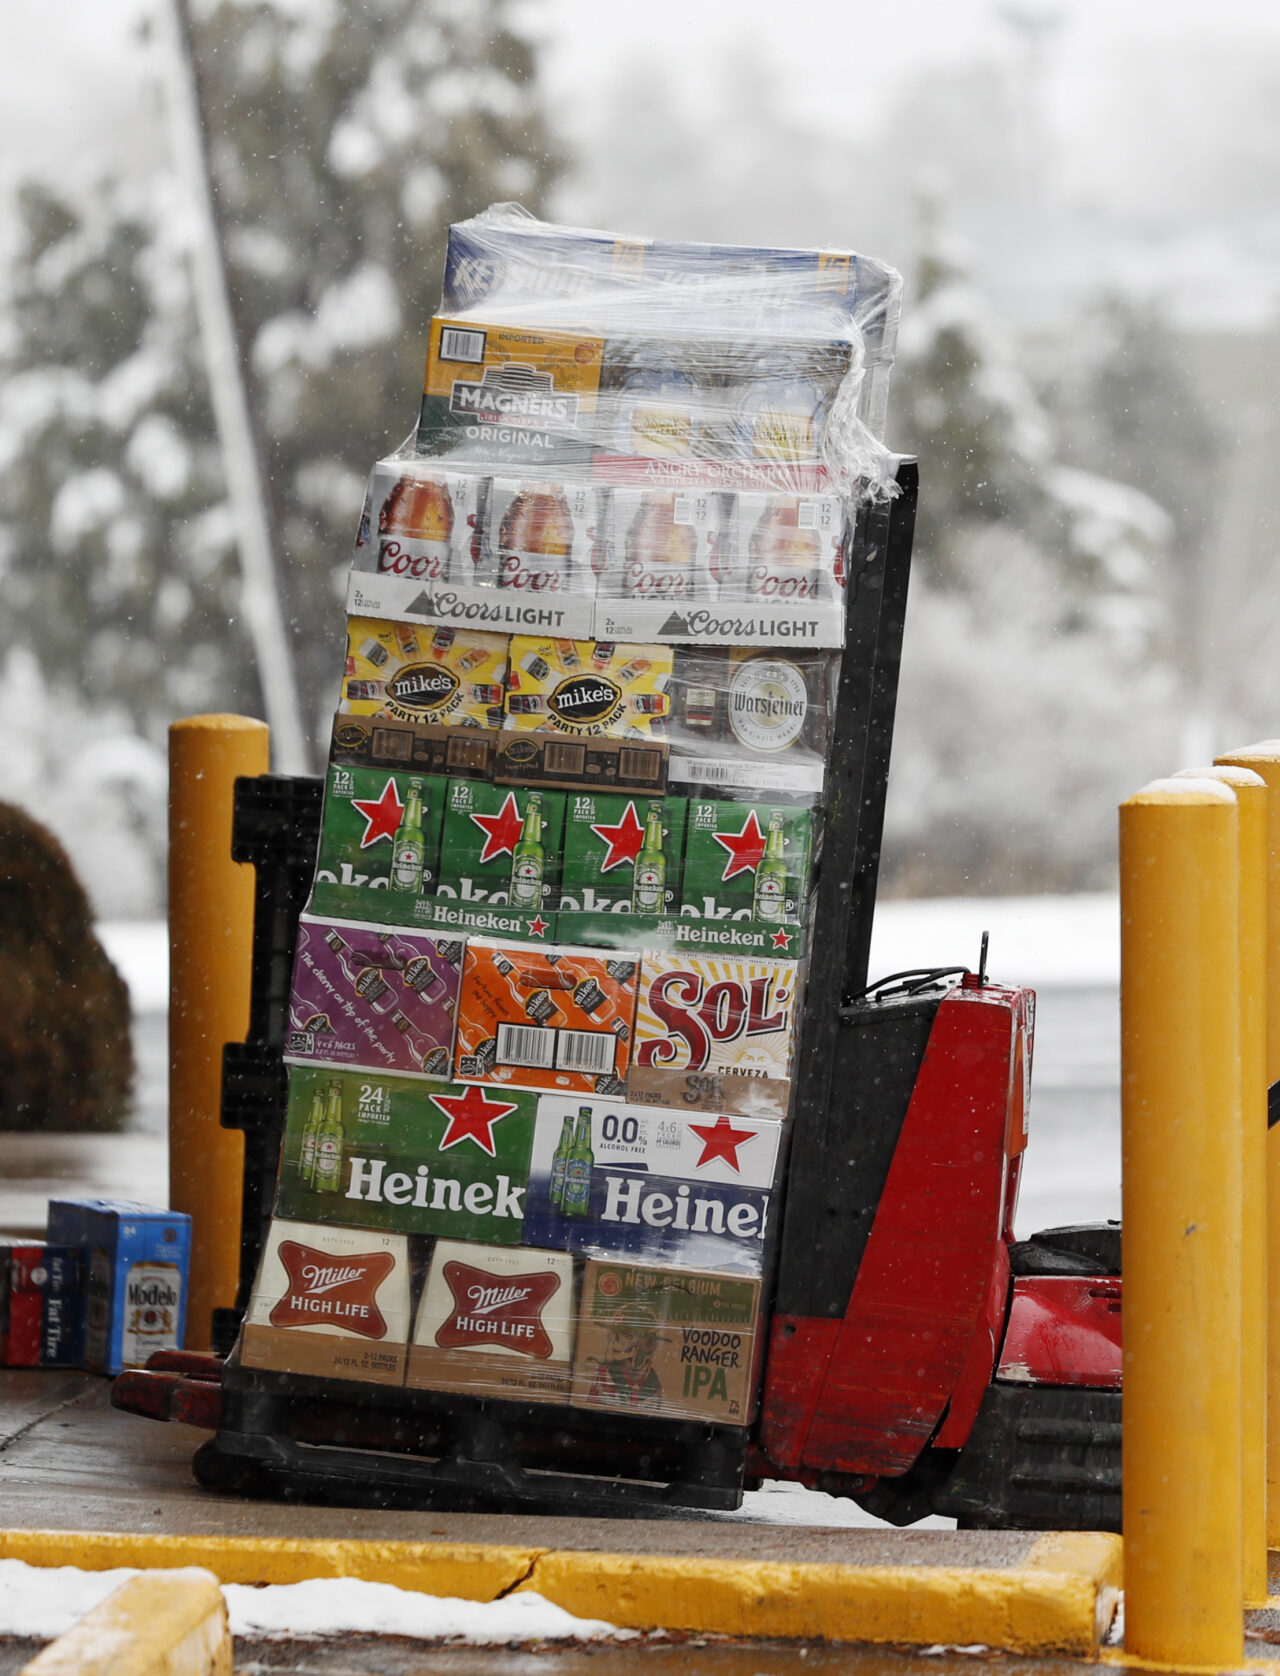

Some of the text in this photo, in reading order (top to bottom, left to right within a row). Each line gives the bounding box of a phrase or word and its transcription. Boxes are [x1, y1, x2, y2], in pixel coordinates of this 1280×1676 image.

[824, 257, 847, 271] 15
[499, 333, 545, 345] IMPORTED
[459, 387, 568, 420] MAGNERS
[466, 426, 555, 448] ORIGINAL
[457, 480, 468, 488] 12
[455, 491, 466, 500] 12
[575, 491, 586, 500] 12
[696, 499, 707, 508] 12
[574, 503, 585, 512] 12
[695, 511, 706, 520] 12
[821, 503, 832, 512] 12
[820, 515, 831, 525] 12
[434, 592, 565, 627] Coors LIGHT
[687, 610, 819, 637] Coors LIGHT
[395, 673, 452, 697] mike's
[556, 685, 614, 709] mike's
[734, 690, 805, 718] Warsteiner
[385, 692, 465, 724] PARTY 12 PACK
[547, 702, 628, 736] PARTY 12 PACK
[333, 771, 349, 785] 12
[452, 786, 468, 799] 12
[574, 797, 590, 809] 12
[697, 805, 713, 817] 12
[433, 905, 521, 932] Heineken
[676, 925, 765, 946] Heineken
[301, 951, 314, 968] The
[311, 968, 336, 993] cherry
[574, 979, 596, 1006] mike's
[341, 999, 356, 1018] top
[526, 989, 548, 1017] mike's
[354, 1017, 371, 1027] of
[362, 1023, 375, 1042] the
[372, 1041, 397, 1065] party
[717, 1066, 769, 1079] CERVEZA
[359, 1085, 383, 1104] 24
[358, 1112, 391, 1121] IMPORTED
[359, 1103, 381, 1113] PACK
[658, 1121, 678, 1133] 4x6
[600, 1142, 628, 1152] ALCOHOL
[631, 1146, 646, 1154] FREE
[381, 1238, 390, 1246] 12
[547, 1257, 555, 1265] 12
[302, 1265, 366, 1293] Miller
[625, 1272, 721, 1297] NEW BELGIUM
[291, 1296, 369, 1318] HIGH LIFE
[467, 1285, 532, 1312] Miller
[46, 1298, 62, 1358] Fat Tire
[456, 1316, 535, 1338] HIGH LIFE
[681, 1326, 741, 1350] VOODOO
[681, 1346, 742, 1369] RANGER
[683, 1365, 727, 1402] IPA
